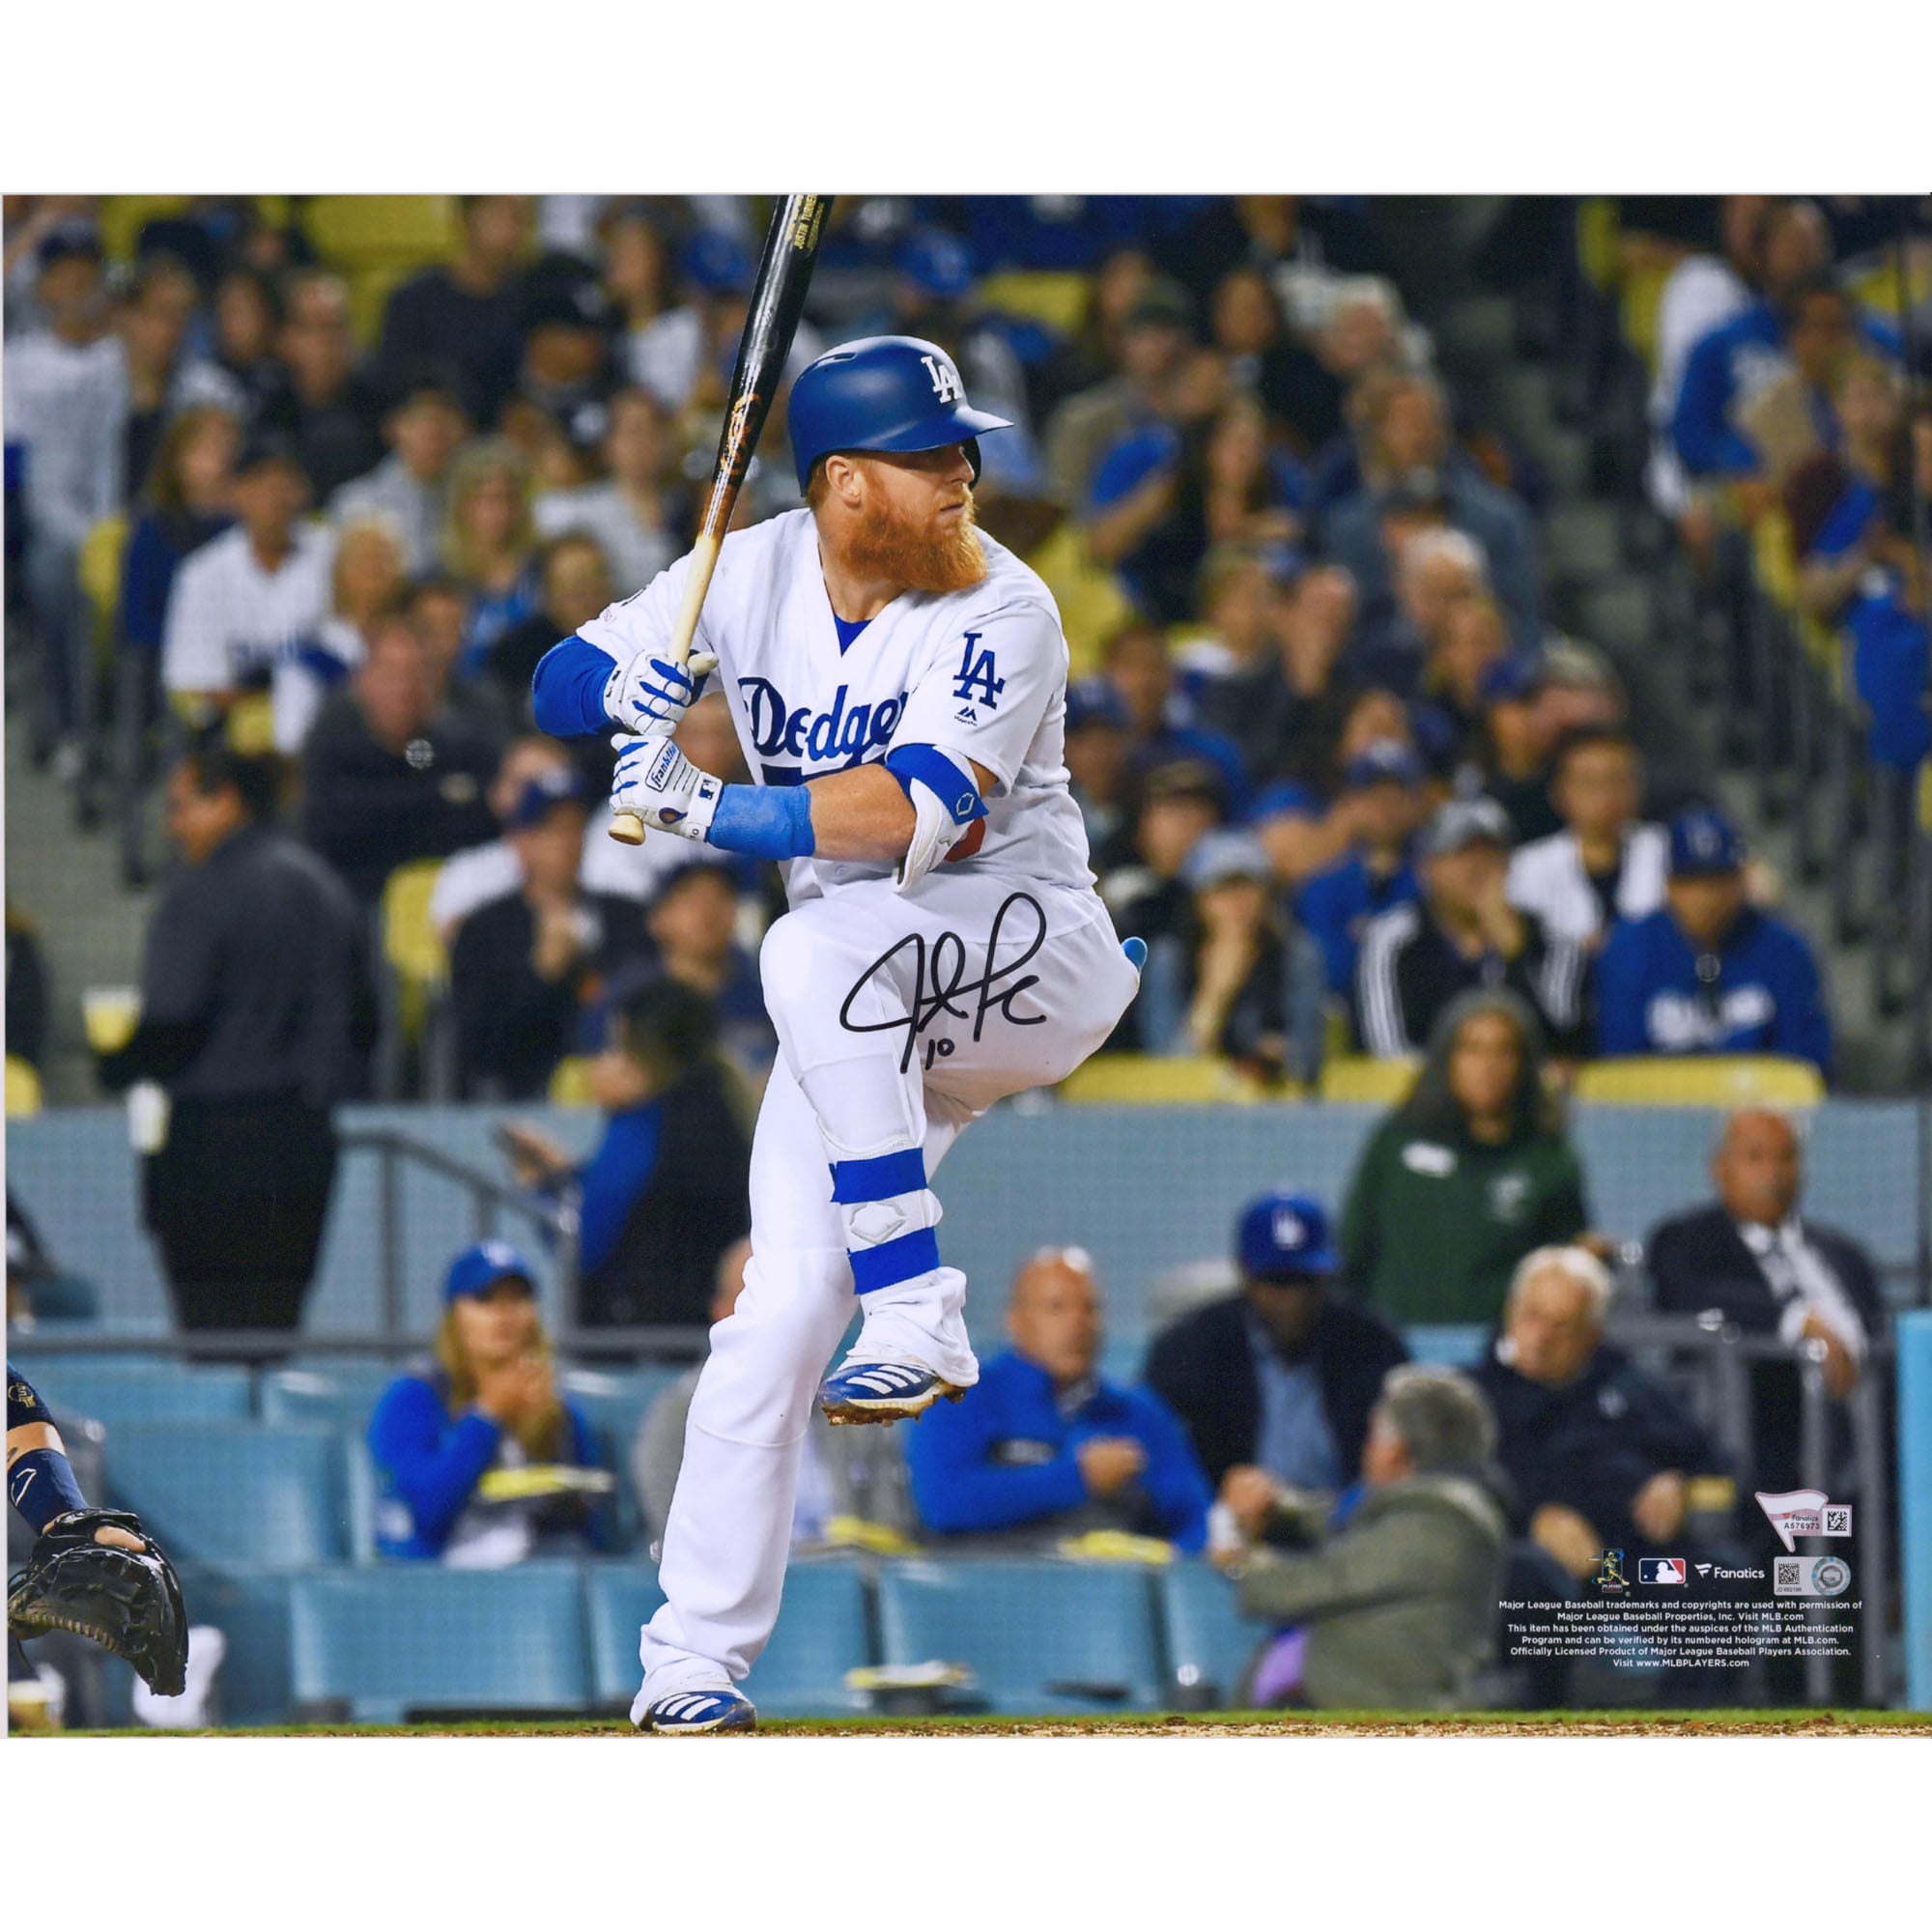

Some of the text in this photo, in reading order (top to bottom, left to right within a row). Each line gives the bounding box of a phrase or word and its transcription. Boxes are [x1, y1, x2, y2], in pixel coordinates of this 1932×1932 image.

[921, 355, 963, 404] LA
[952, 632, 1006, 710] LA
[737, 677, 909, 770] Dodge
[924, 1038, 955, 1070] 10
